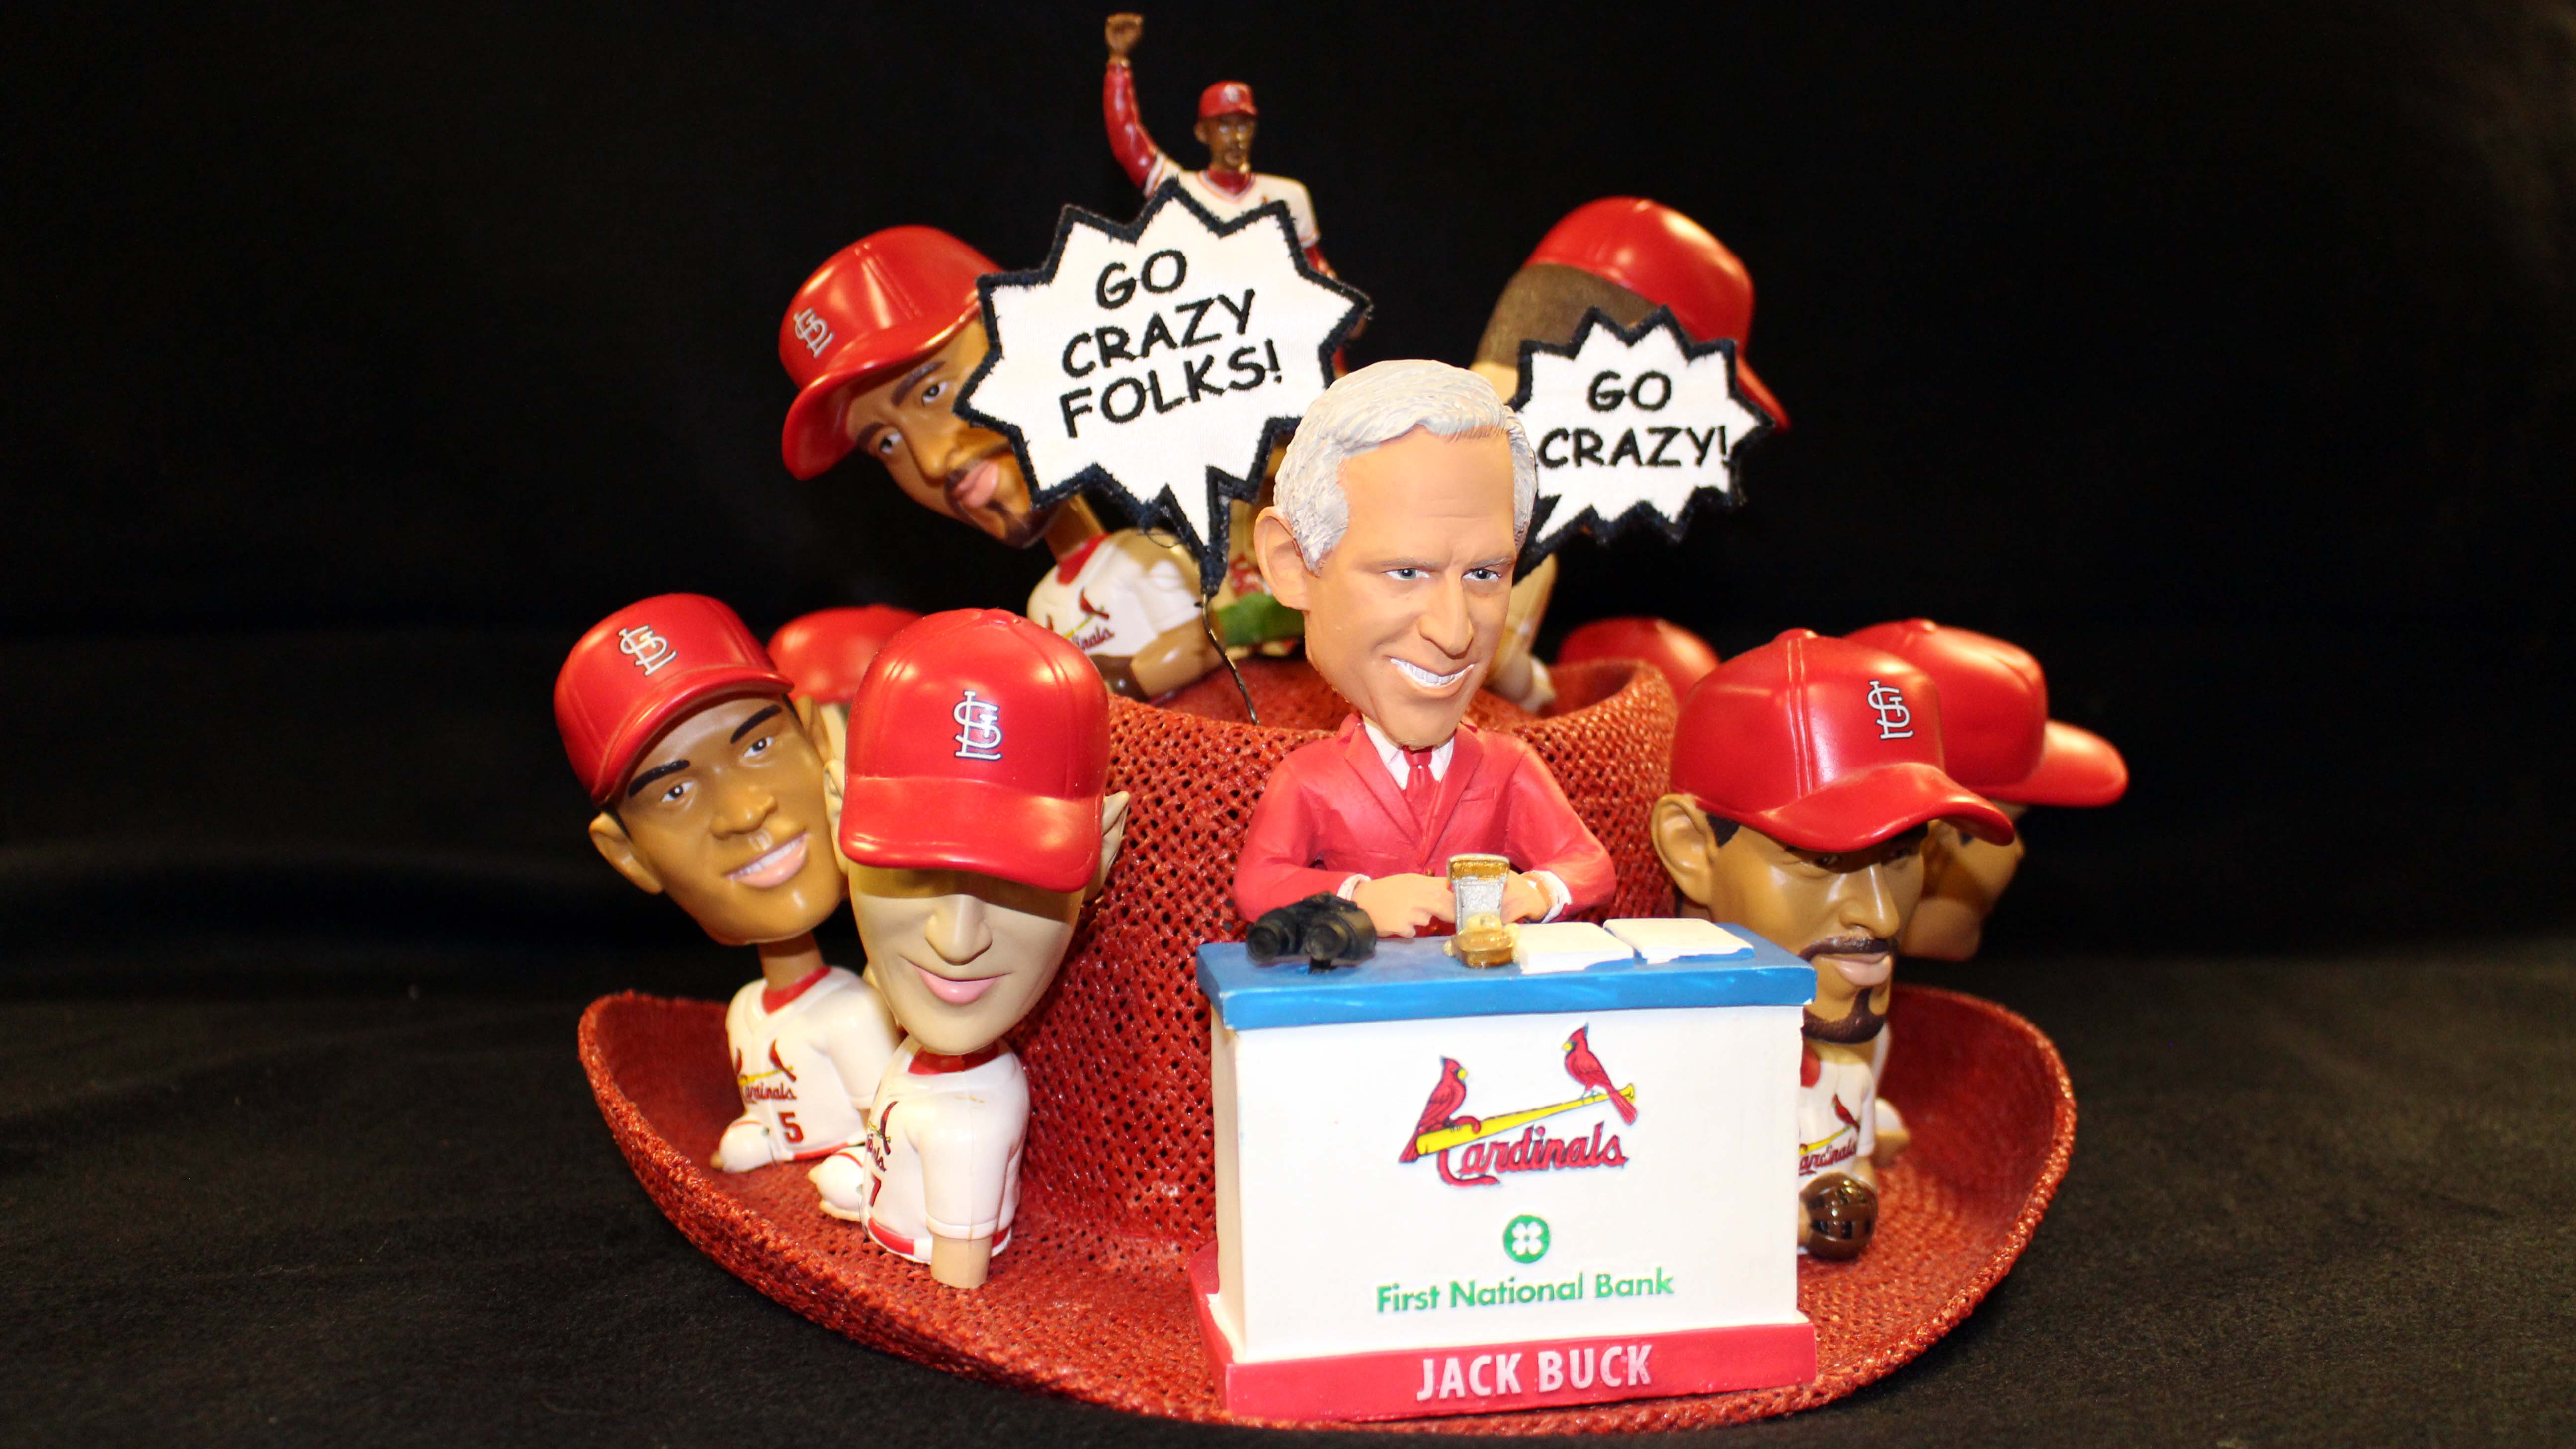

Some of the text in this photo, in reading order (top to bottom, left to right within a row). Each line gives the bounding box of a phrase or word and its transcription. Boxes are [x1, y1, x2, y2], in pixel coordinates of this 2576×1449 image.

[1095, 249, 1187, 309] GO
[1062, 289, 1255, 378] CRAZY
[1060, 338, 1282, 438] FOLKS!
[1587, 370, 1672, 412] GO
[1539, 425, 1731, 469] CRAZY!
[778, 1112, 804, 1143] 5
[1436, 1116, 1629, 1187] Cardinals
[1376, 1267, 1674, 1314] First National Bank
[1416, 1344, 1653, 1402] JACK BUCK
